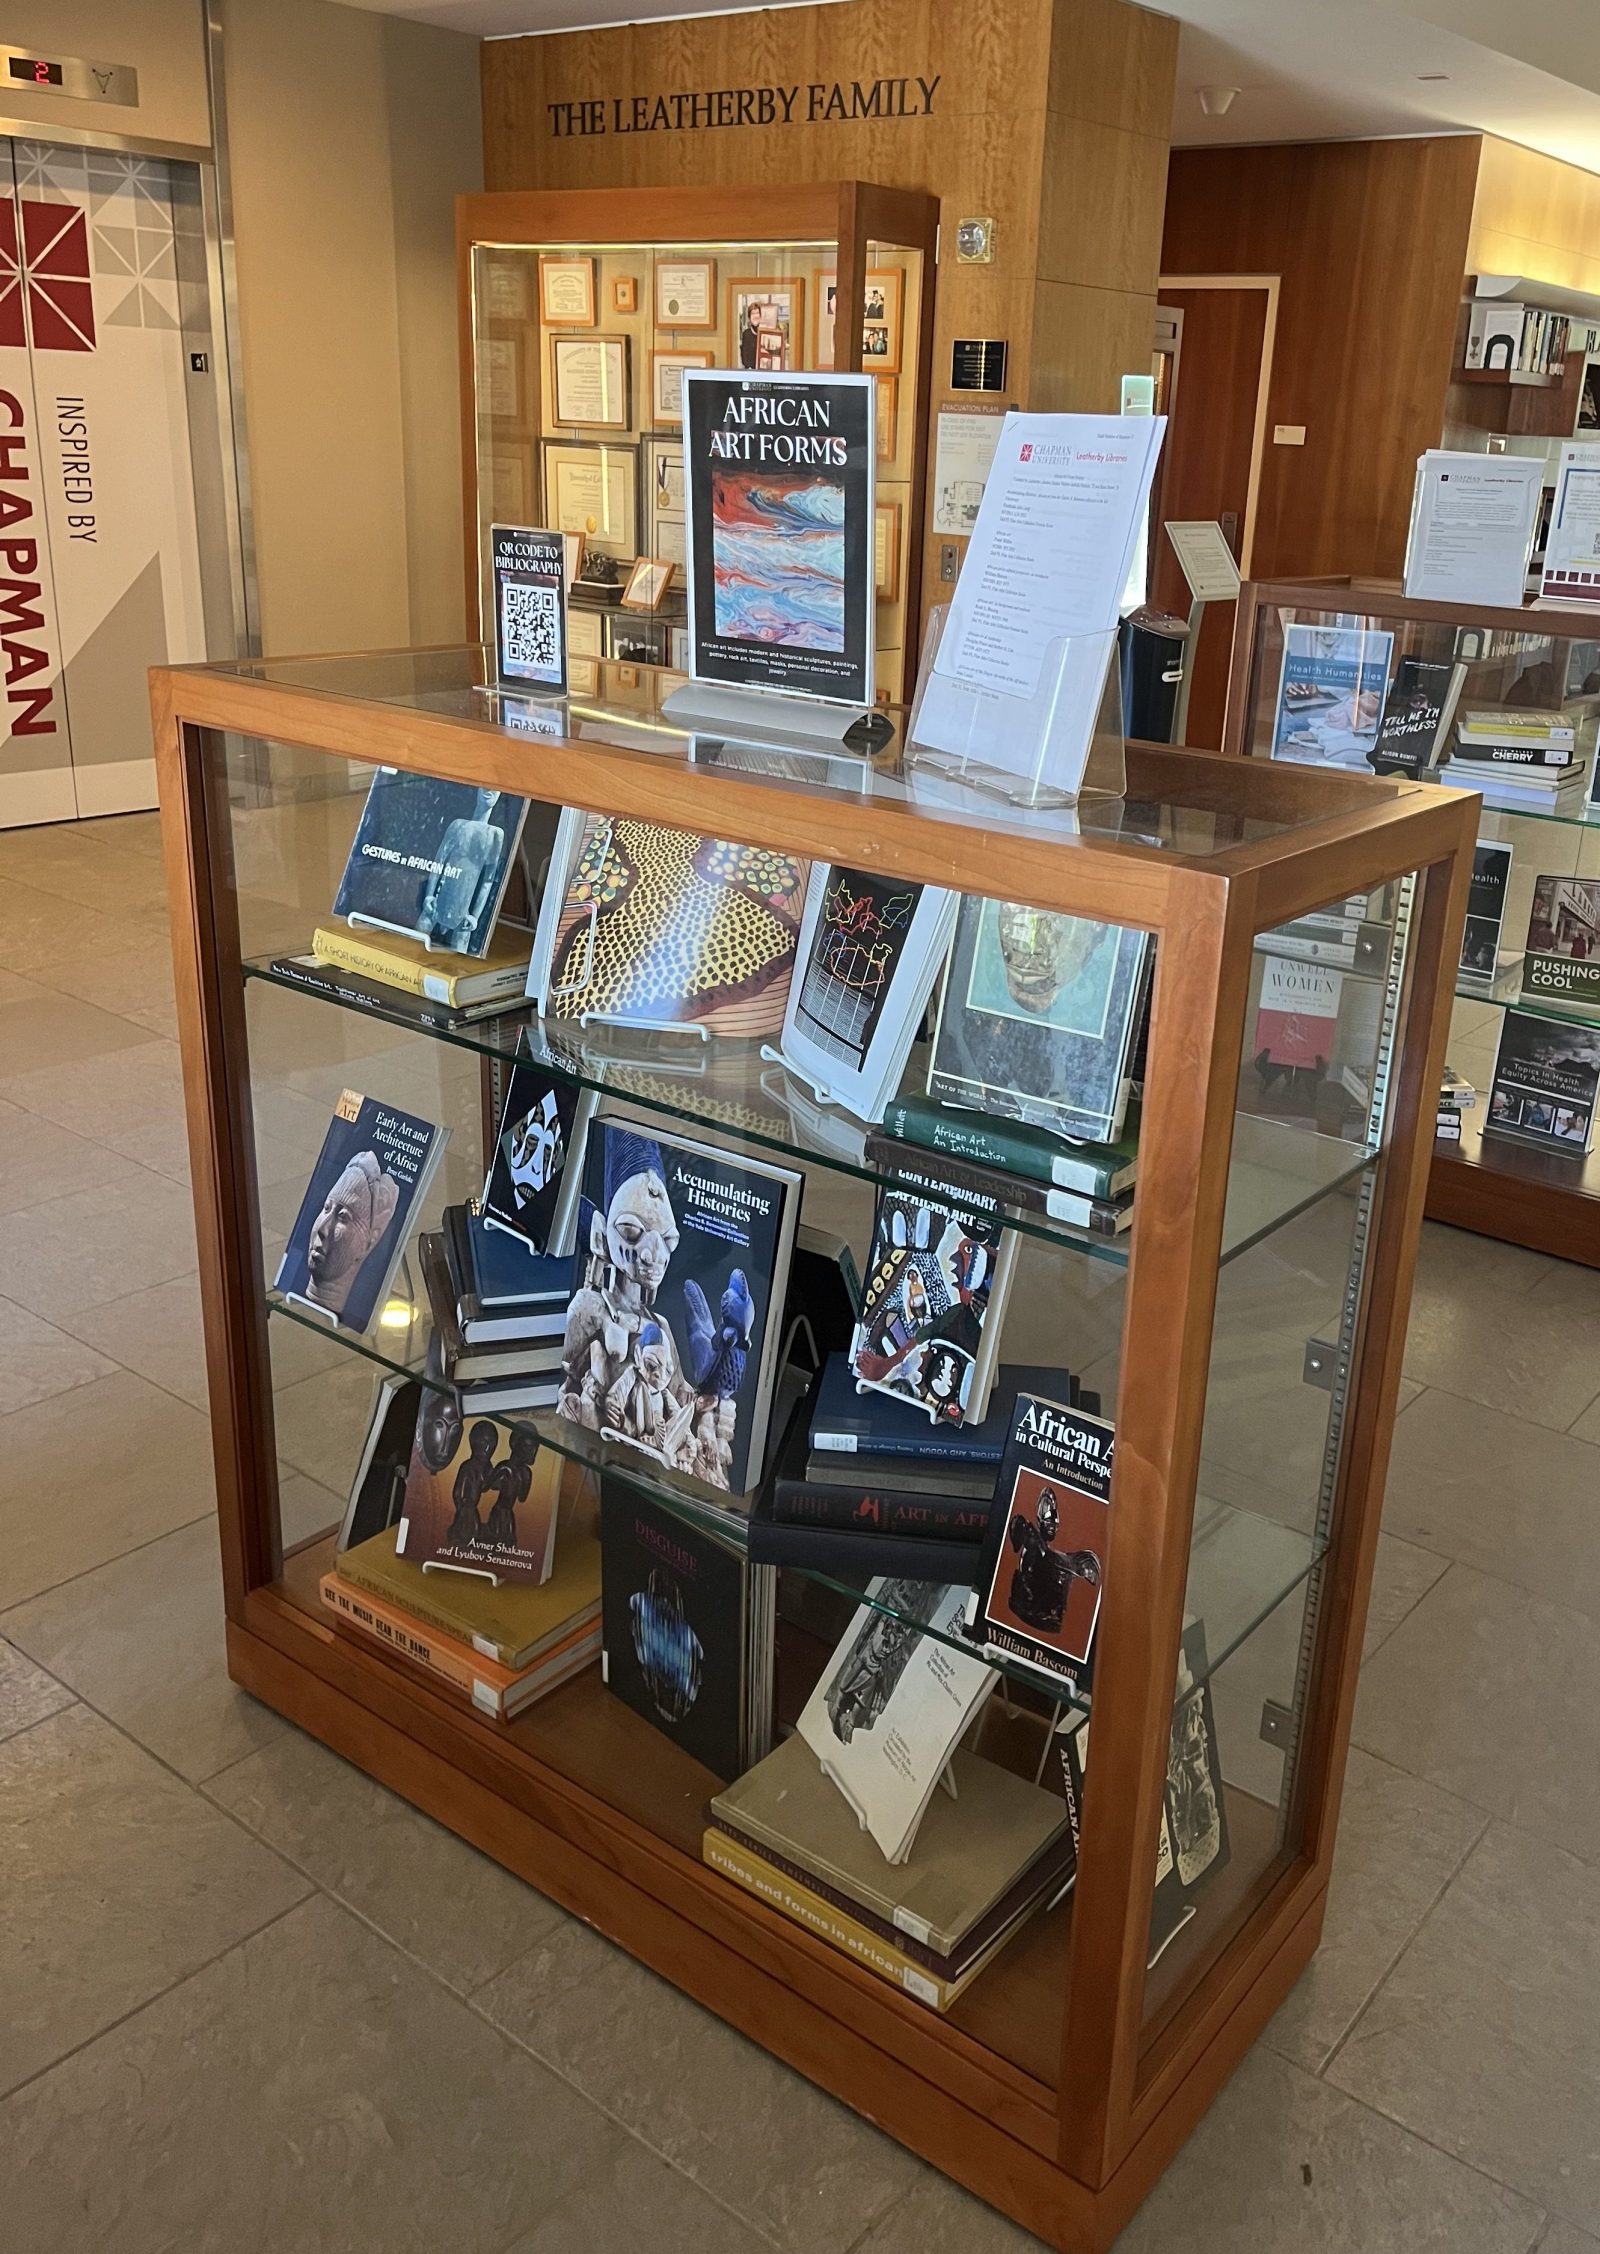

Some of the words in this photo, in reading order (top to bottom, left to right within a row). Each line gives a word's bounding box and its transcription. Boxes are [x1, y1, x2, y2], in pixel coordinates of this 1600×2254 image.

[34, 61, 50, 84] 2
[547, 101, 605, 136] THE
[613, 86, 799, 133] LEATHERBY
[806, 75, 941, 122] FAMILY
[723, 396, 830, 428] AFRICAN
[942, 404, 981, 412] EVACUATION
[983, 405, 999, 413] PLAN
[56, 397, 93, 503] INSPIRED
[709, 431, 755, 460] ART
[760, 434, 848, 466] FORMS
[1034, 444, 1072, 456] CHAPMAN
[1076, 451, 1104, 464] Leatherby
[1105, 453, 1128, 463] Libraries
[1032, 455, 1071, 466] UNIVERSITY
[67, 515, 98, 543] BY
[499, 541, 514, 556] QR
[515, 543, 543, 558] CODE
[544, 546, 558, 559] TO
[0, 389, 57, 737] CHAPMAN
[495, 555, 563, 575] BIBLIOGRAPHY
[780, 653, 803, 661] historical
[788, 663, 810, 671] personal
[1325, 668, 1382, 680] Humanties
[1382, 720, 1437, 738] WORTHLESS
[1384, 715, 1405, 727] TELL
[1408, 710, 1423, 723] ME
[1425, 708, 1440, 719] I'M
[1492, 751, 1533, 762] CHERRY
[362, 844, 401, 863] GESTURES
[407, 856, 444, 874] AFRICAN
[443, 866, 462, 879] ART
[1281, 961, 1327, 976] UNWELL
[1533, 959, 1600, 980] PUSHING
[1272, 973, 1335, 993] WOMEN
[1531, 973, 1573, 989] COOL
[1501, 1068, 1528, 1081] Equity
[1530, 1075, 1557, 1088] Across
[1560, 1082, 1594, 1098] America
[1513, 1063, 1539, 1076] Topics
[1552, 1073, 1580, 1086] Health
[337, 1104, 357, 1120] Art
[894, 1108, 906, 1138] Willett
[375, 1111, 399, 1133] Early
[398, 1122, 413, 1137] Art
[412, 1131, 429, 1143] and
[933, 1124, 967, 1142] African
[969, 1134, 987, 1146] Art
[372, 1127, 424, 1157] Architecture
[933, 1136, 946, 1148] An
[950, 1140, 1006, 1163] Introduction
[383, 1150, 396, 1162] of
[393, 1152, 419, 1173] Africa
[672, 1166, 771, 1216] Accumulating
[687, 1187, 751, 1223] Histories
[950, 1208, 976, 1227] ART
[1018, 1404, 1101, 1458] African
[1101, 1439, 1115, 1462] A
[919, 1447, 948, 1455] VODUN
[1015, 1428, 1027, 1444] in
[1029, 1433, 1075, 1462] Cultural
[1077, 1452, 1112, 1478] Perspe
[1042, 1459, 1054, 1470] An
[1056, 1463, 1104, 1490] Introduction
[894, 1505, 932, 1521] ART
[467, 1537, 494, 1550] Avner
[495, 1542, 535, 1558] Shakarov
[635, 1519, 697, 1569] DISGUISE
[436, 1546, 454, 1556] and
[454, 1546, 485, 1562] Lyubov
[486, 1553, 532, 1570] Senatorova
[325, 1587, 336, 1603] SEE
[339, 1595, 350, 1611] THE
[352, 1604, 373, 1625] MUSIC
[376, 1618, 392, 1637] HEAR
[395, 1630, 407, 1646] THE
[410, 1639, 431, 1660] DANCE
[987, 1627, 1031, 1659] William
[1034, 1648, 1078, 1680] Bascom
[1060, 1748, 1078, 1829] AFRICAN
[711, 1851, 753, 1883] tribes
[755, 1880, 782, 1900] and
[785, 1895, 829, 1931] forms
[832, 1924, 846, 1941] in
[848, 1936, 902, 1978] african
